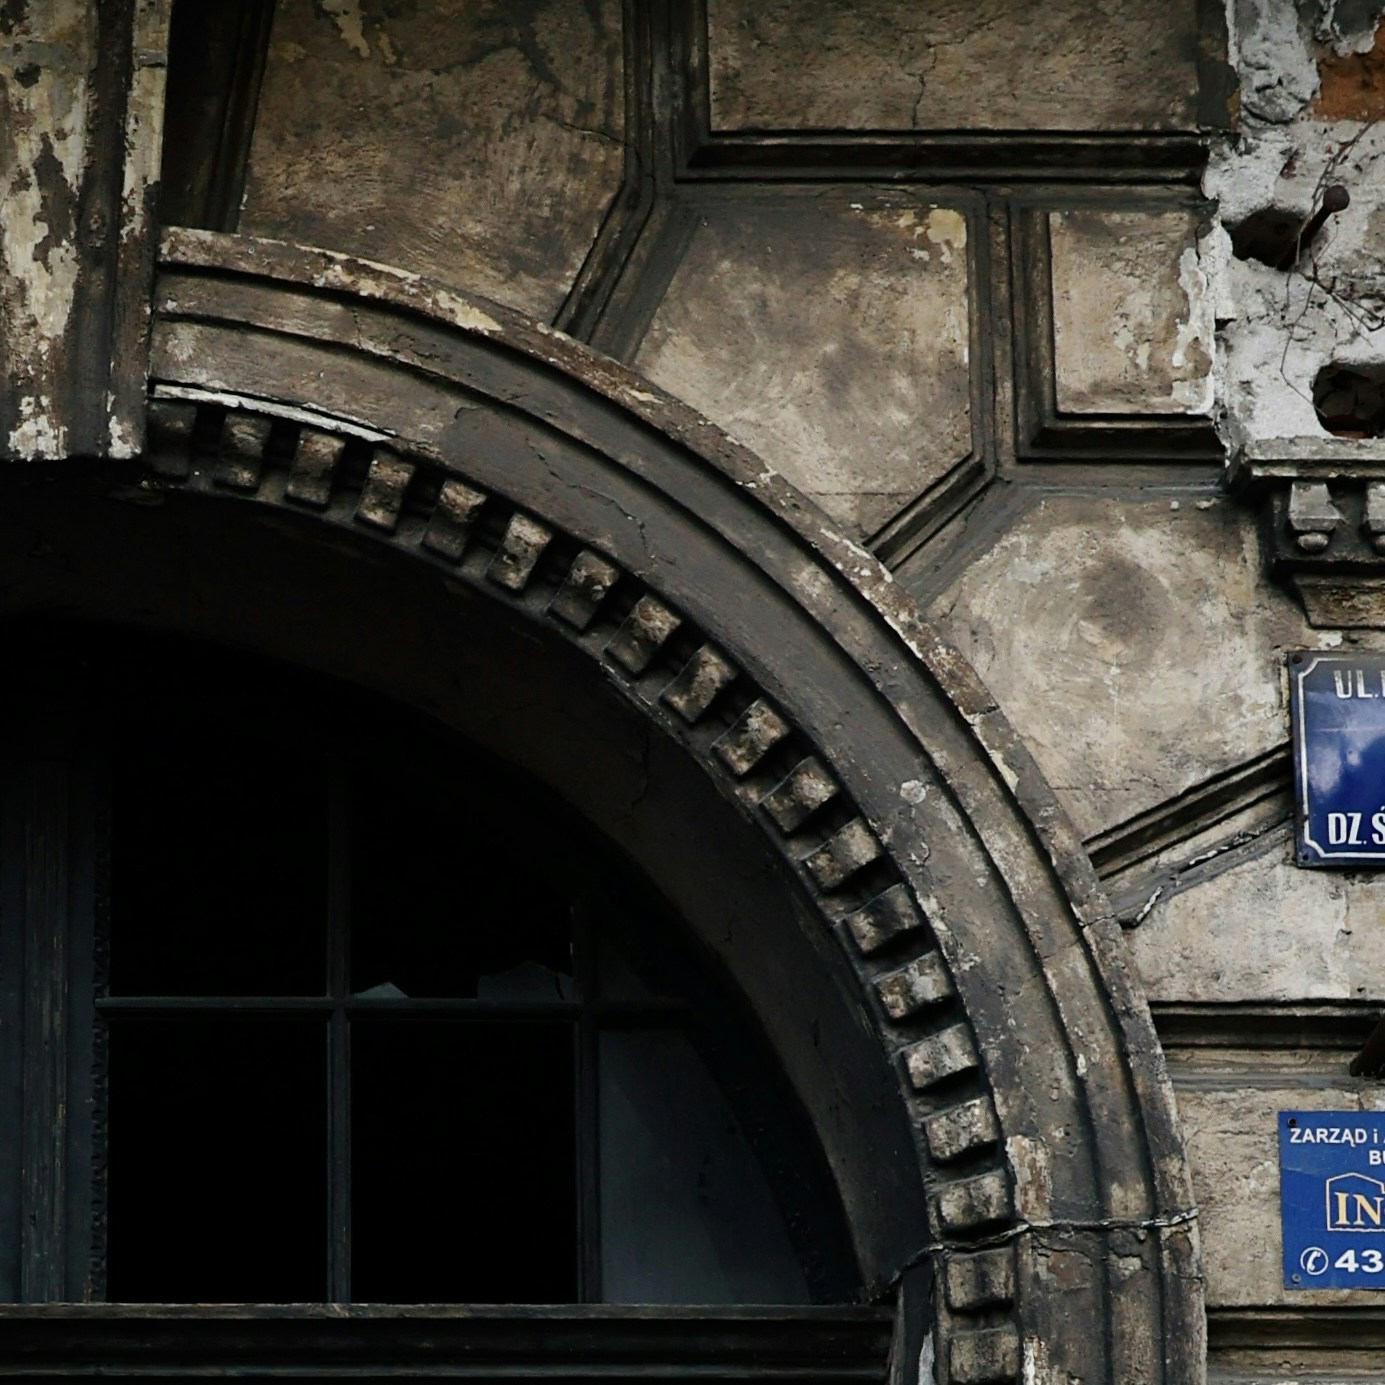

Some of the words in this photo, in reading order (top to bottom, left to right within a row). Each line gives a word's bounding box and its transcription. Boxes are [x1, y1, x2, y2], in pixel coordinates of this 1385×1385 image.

[1327, 812, 1367, 846] DZ.
[1289, 1127, 1368, 1148] ZARZĄD
[1372, 1128, 1379, 1144] i
[1334, 1191, 1385, 1227] IN
[1333, 1248, 1385, 1274] 43
